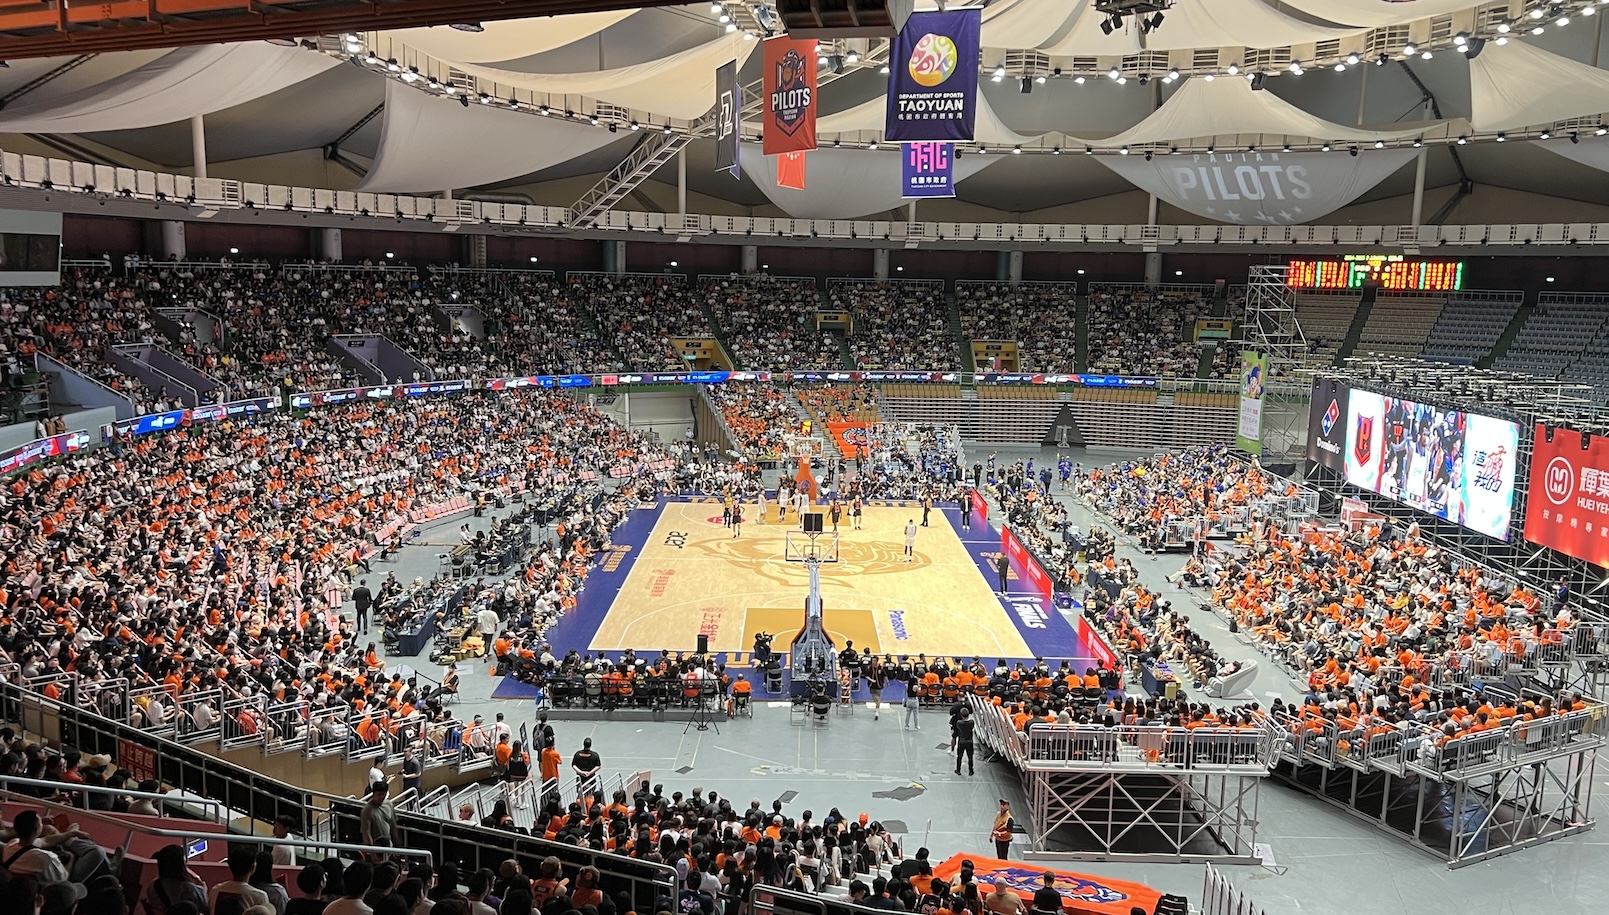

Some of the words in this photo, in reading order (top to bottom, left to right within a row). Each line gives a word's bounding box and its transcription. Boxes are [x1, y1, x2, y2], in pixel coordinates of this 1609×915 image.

[772, 87, 811, 111] PILOTS
[899, 99, 964, 112] TAOYUAN
[911, 176, 947, 185] 桃園市政府
[1172, 165, 1312, 200] PILOTS
[1579, 466, 1609, 499] 輝葉
[1576, 496, 1595, 511] HUEI
[663, 530, 689, 549] acer
[888, 609, 912, 641] Panasonic
[1012, 603, 1047, 629] FINALS
